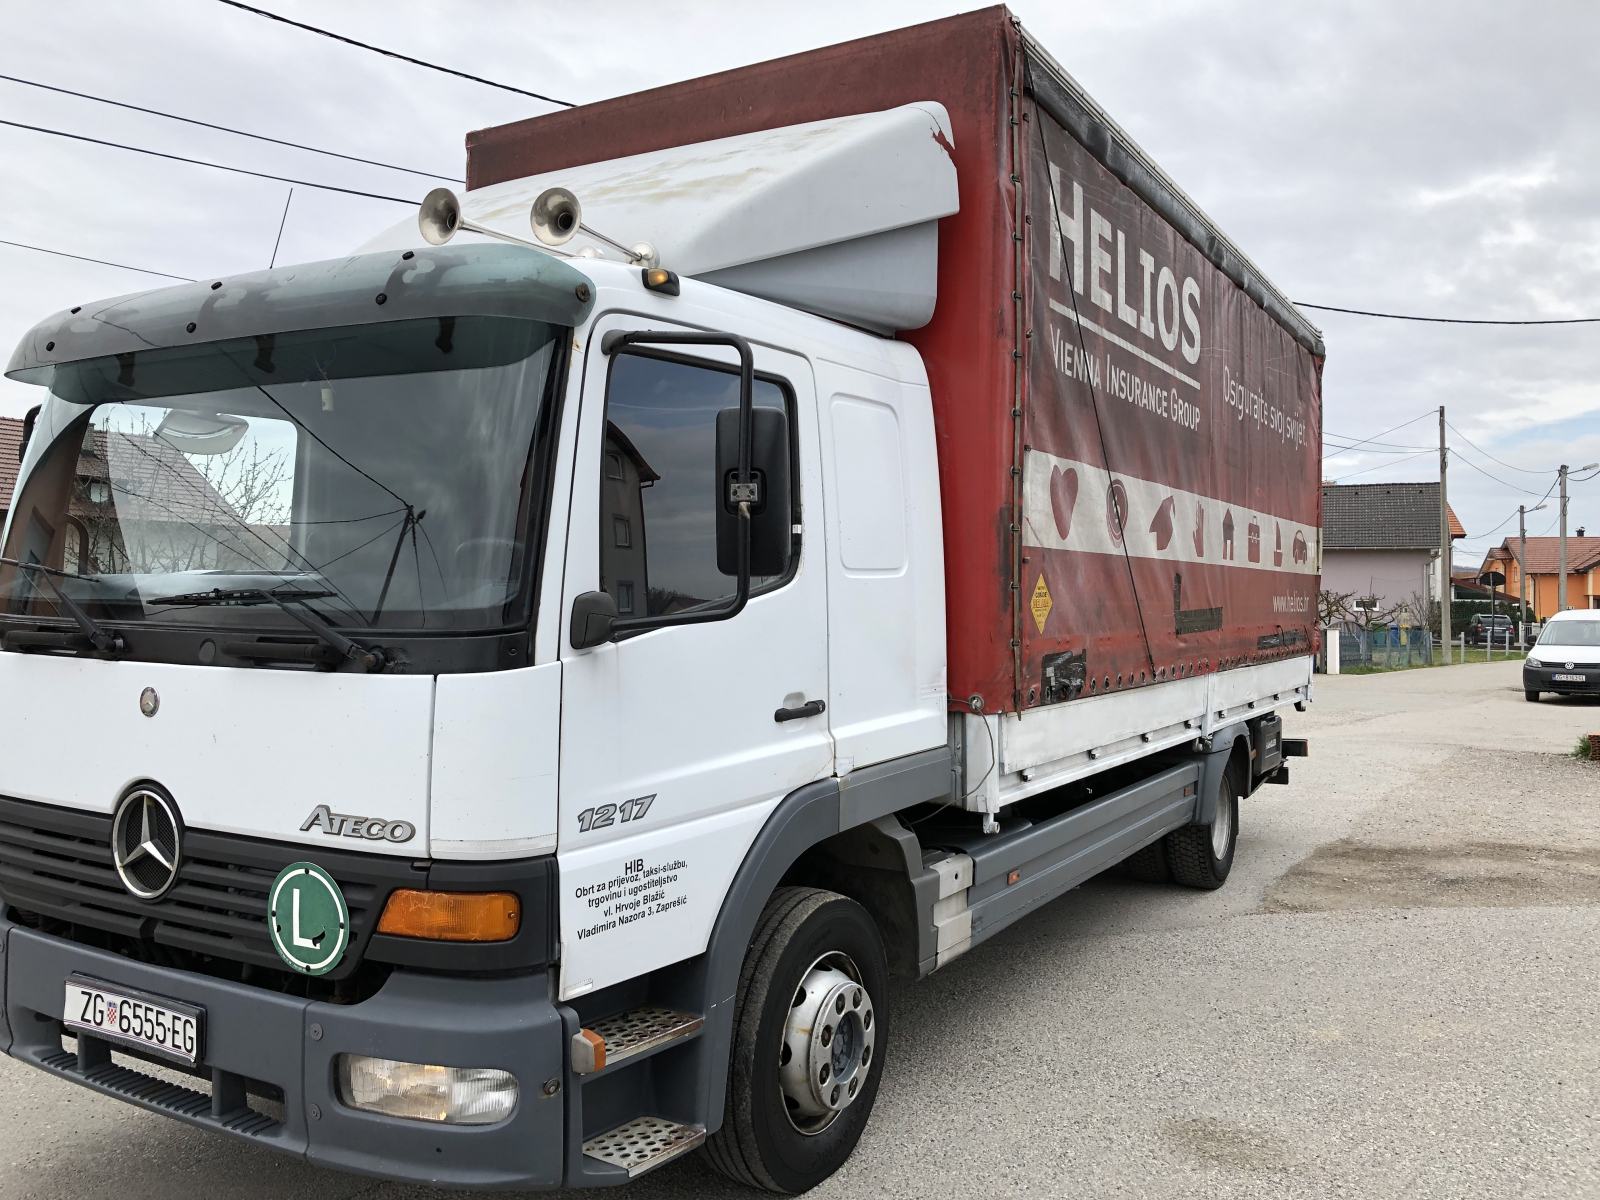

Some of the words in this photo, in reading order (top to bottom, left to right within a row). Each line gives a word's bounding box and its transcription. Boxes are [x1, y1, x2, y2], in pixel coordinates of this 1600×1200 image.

[1049, 161, 1201, 365] HELIOS
[1050, 324, 1102, 389] VIENNA
[1106, 354, 1168, 418] INSURANCE
[1170, 388, 1201, 431] GROUP
[577, 793, 657, 833] 1217
[575, 887, 595, 899] Obrt
[596, 883, 606, 892] za
[608, 873, 641, 892] prijevoz,
[624, 858, 644, 876] HIB
[588, 890, 622, 909] trgovinu
[628, 873, 678, 896] ugostiteljstvo
[603, 906, 613, 917] vl.
[615, 899, 641, 914] Hrvoje
[642, 890, 665, 905] Blažić
[293, 888, 321, 950] L
[577, 921, 616, 940] Vladimira
[618, 911, 646, 926] Nazora
[655, 895, 687, 914] Zaprešić
[80, 990, 105, 1027] ZG
